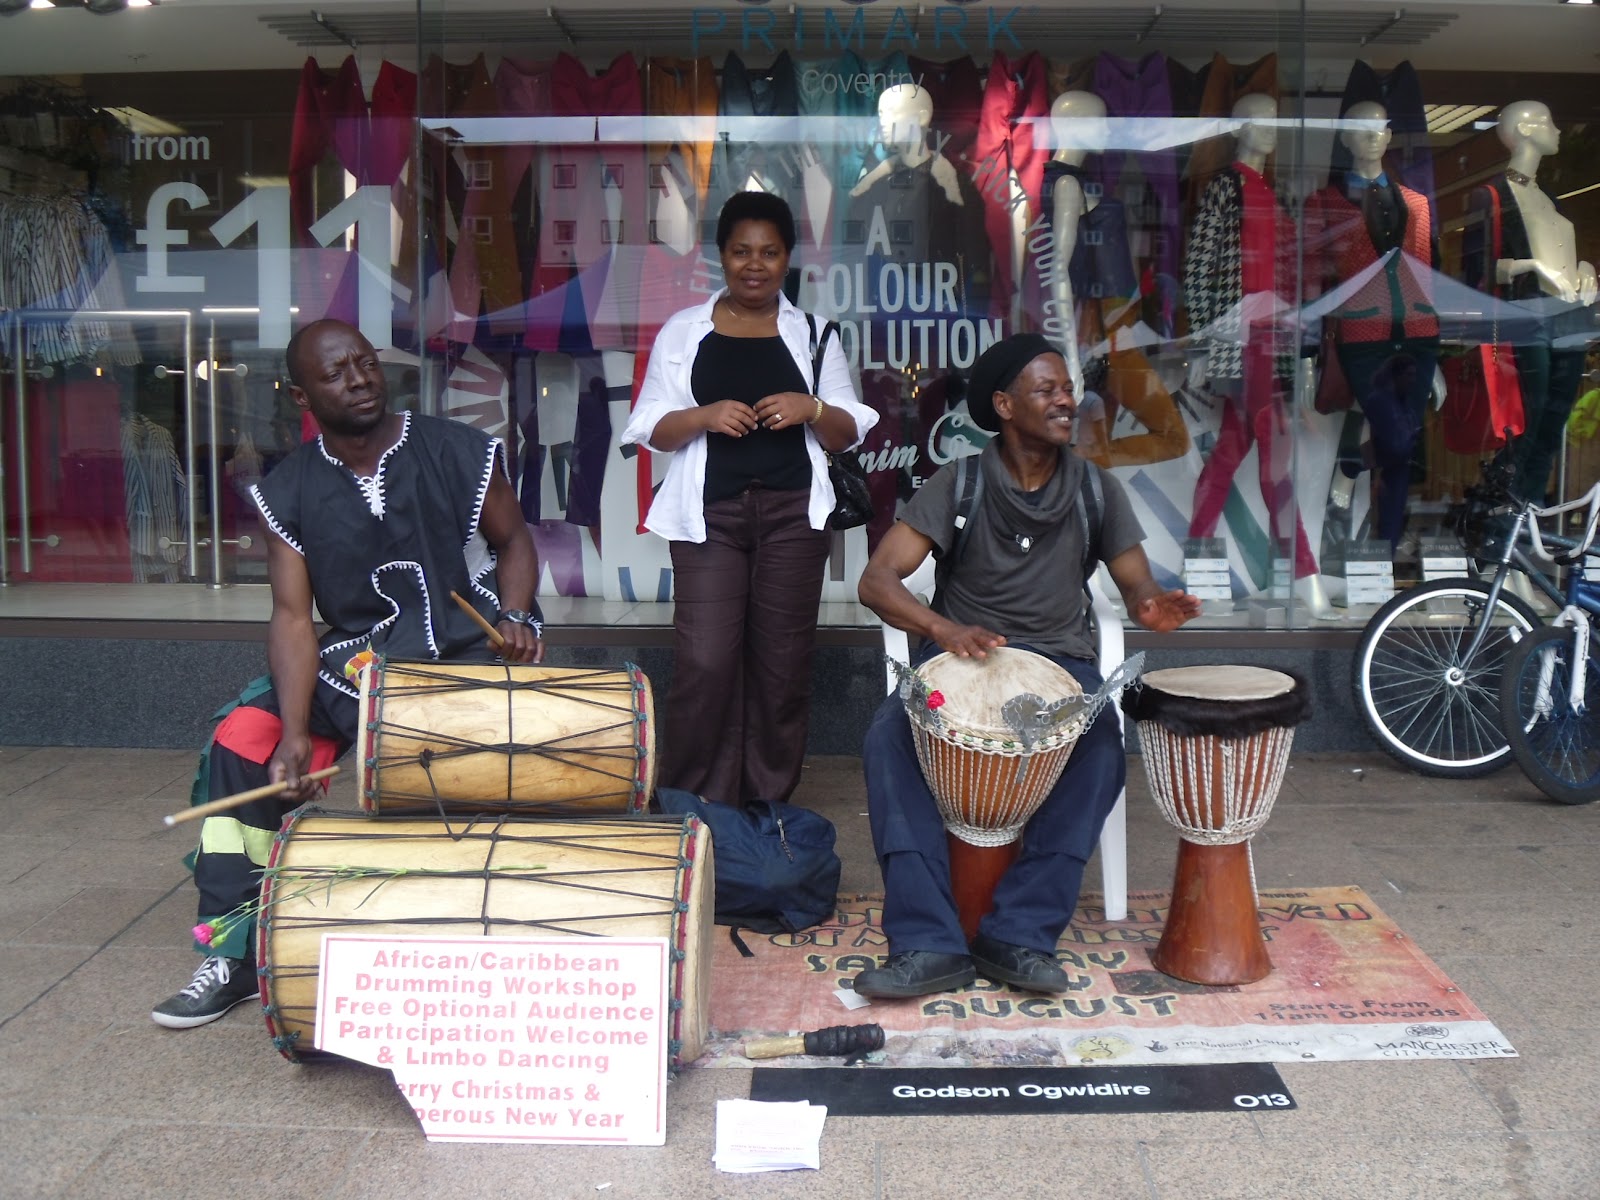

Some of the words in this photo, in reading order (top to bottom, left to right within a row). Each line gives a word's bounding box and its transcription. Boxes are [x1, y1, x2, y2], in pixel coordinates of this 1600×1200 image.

[692, 6, 1025, 52] PRIMARK
[802, 69, 925, 98] Coventry
[132, 134, 210, 160] from
[865, 205, 892, 256] A
[135, 181, 393, 349] £11
[799, 262, 958, 314] COLOUR
[840, 318, 1003, 370] OLUTION
[858, 439, 919, 474] nim
[373, 950, 620, 972] African/Caribbean
[355, 973, 492, 998] Drumming
[503, 976, 637, 1001] Workshop
[335, 996, 392, 1016] Free
[403, 998, 516, 1021] Optional
[527, 1001, 655, 1021] Audience
[922, 994, 1178, 1019] AUGUST
[1254, 1011, 1328, 1021] 11am
[1338, 1007, 1460, 1019] Onwards
[1268, 1001, 1353, 1011] Starts
[1363, 999, 1430, 1010] From
[339, 1021, 515, 1045] Participation
[526, 1025, 648, 1045] Welcome
[1200, 1040, 1253, 1048] National
[1374, 1040, 1504, 1051] MANCHESTER
[377, 1046, 394, 1064] &
[406, 1047, 487, 1066] Limbo
[498, 1049, 609, 1074] Dancing
[1430, 1049, 1500, 1057] COUNCI
[452, 1079, 575, 1101] Christmas
[584, 1083, 600, 1101] &
[892, 1084, 1010, 1099] Godson
[1018, 1083, 1151, 1100] Ogwidire
[505, 1107, 558, 1126] New
[568, 1109, 624, 1127] Year
